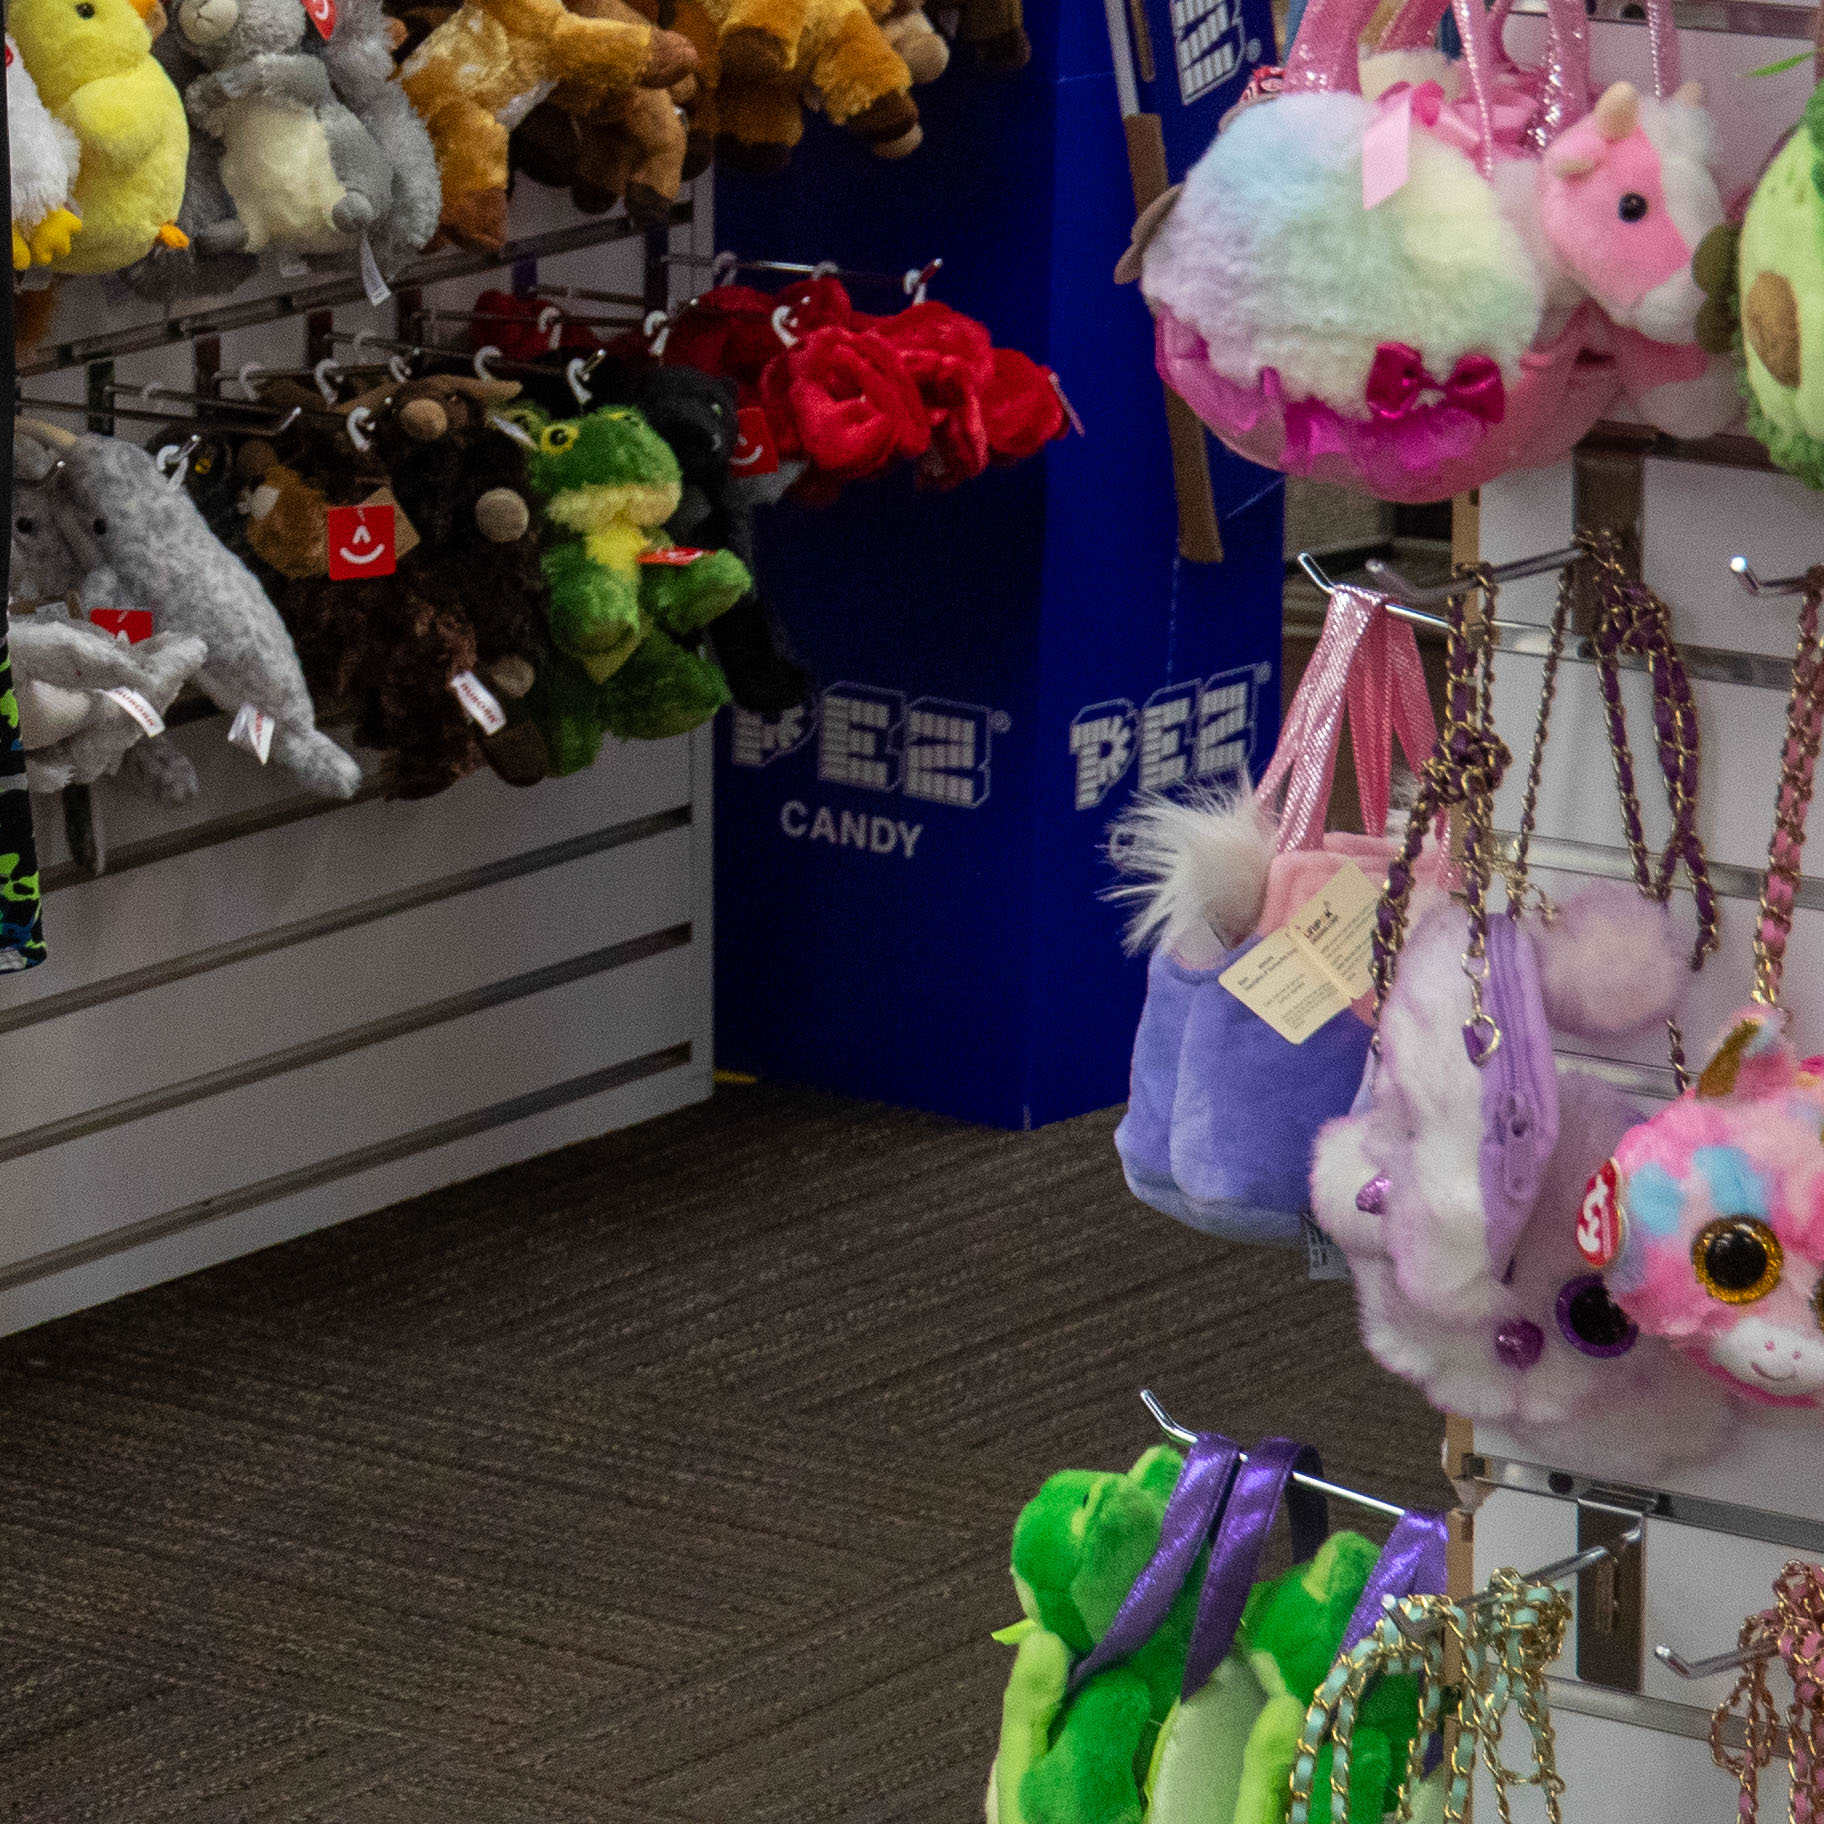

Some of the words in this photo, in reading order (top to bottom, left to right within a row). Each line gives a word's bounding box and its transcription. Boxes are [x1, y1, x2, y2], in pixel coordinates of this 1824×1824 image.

[732, 679, 993, 810] PEZ
[1068, 665, 1263, 813] PEZ
[779, 799, 924, 858] CANDY
